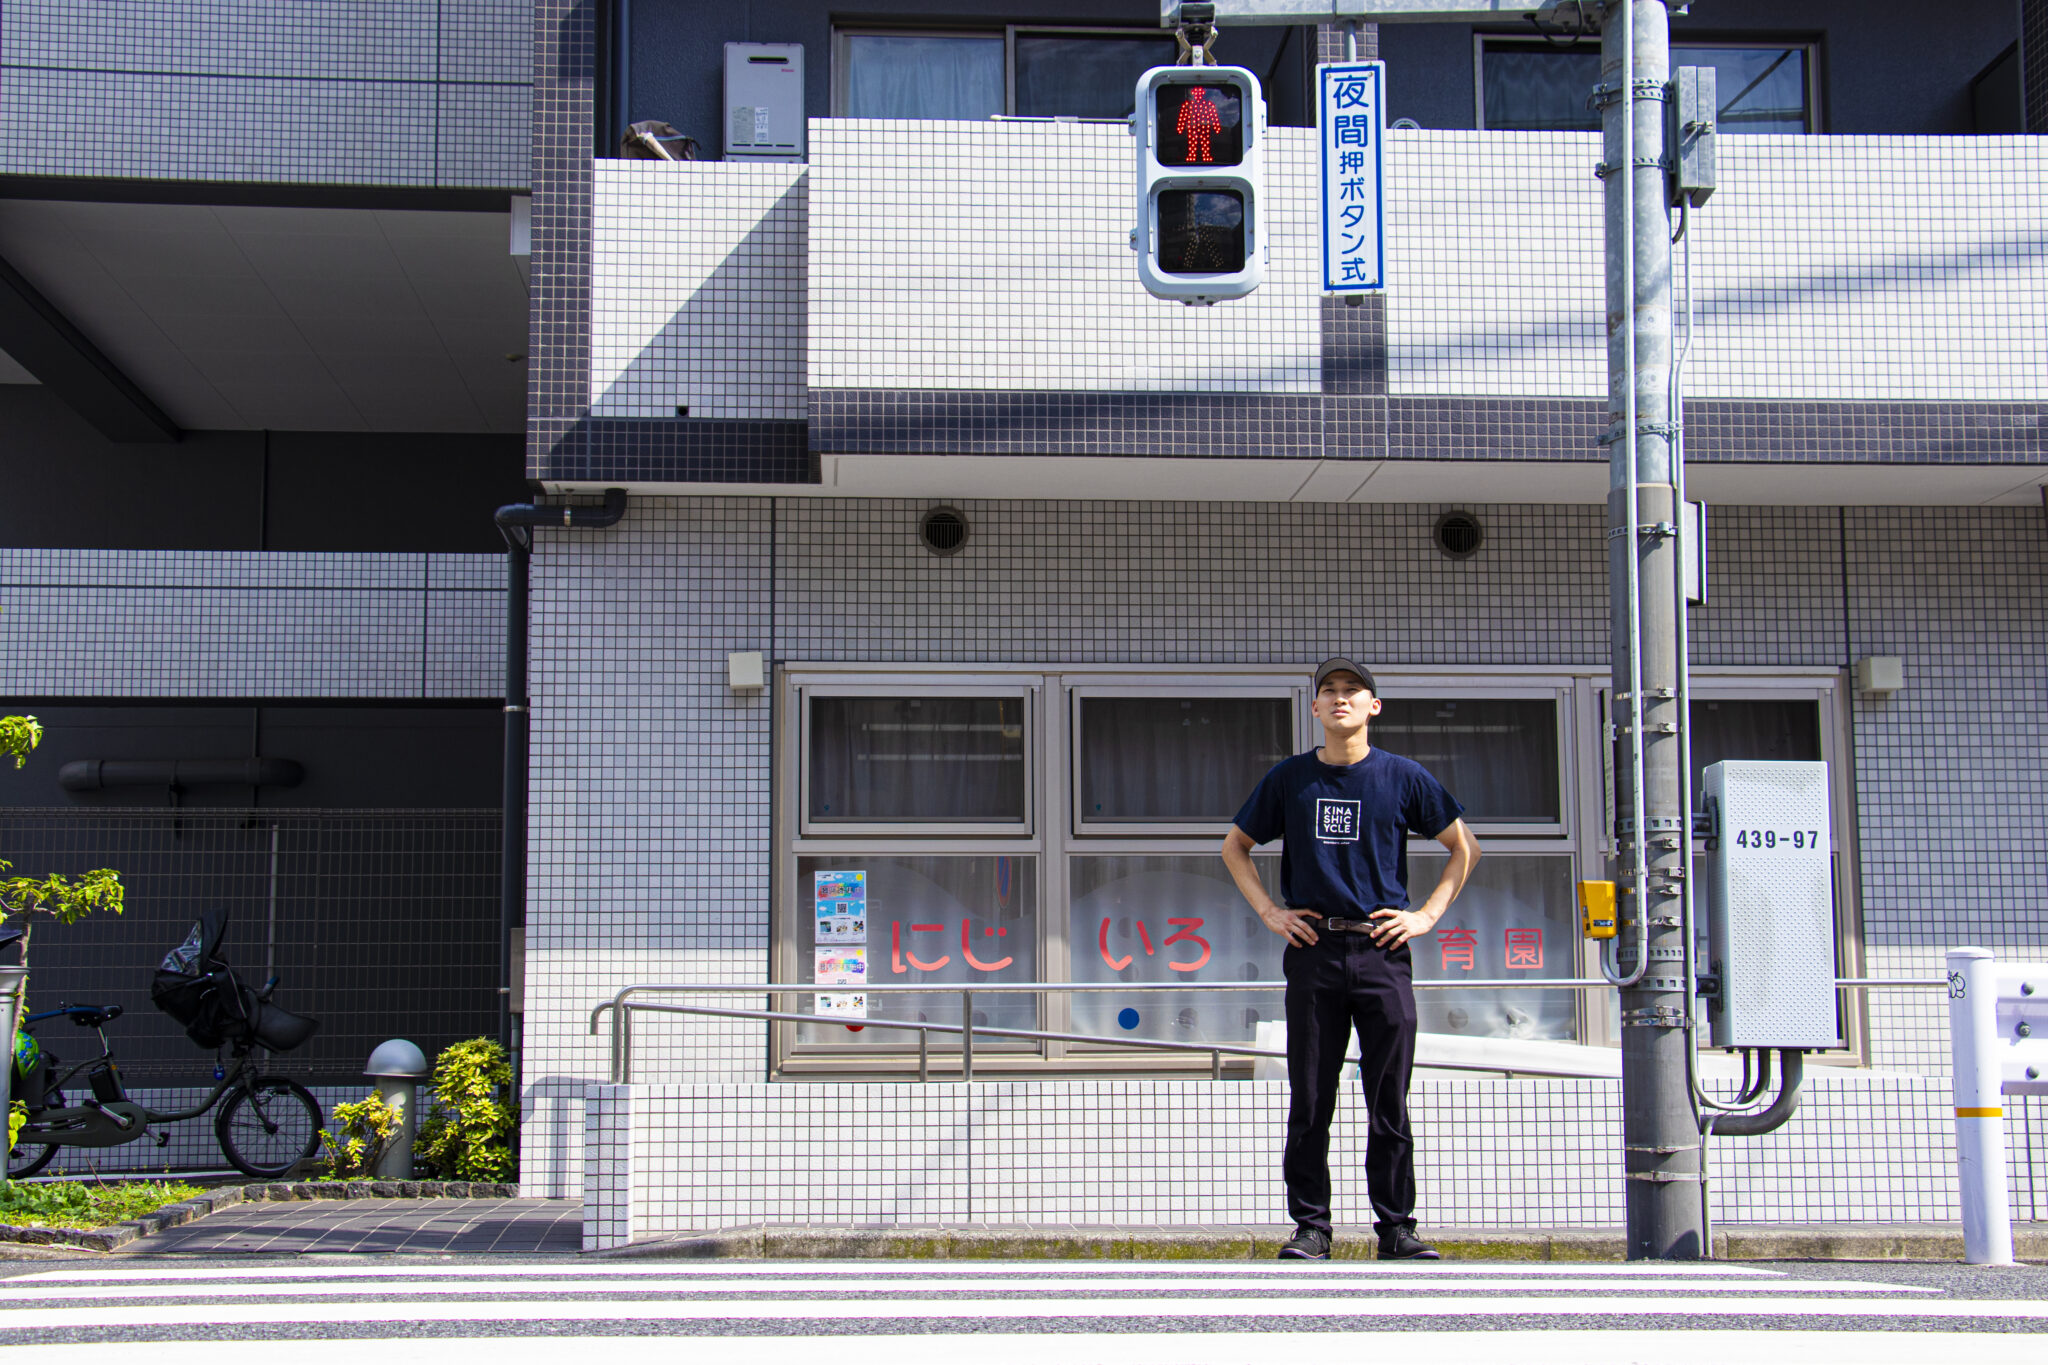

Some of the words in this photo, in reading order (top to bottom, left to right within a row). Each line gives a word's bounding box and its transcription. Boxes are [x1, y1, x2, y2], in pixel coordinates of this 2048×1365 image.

[1333, 74, 1369, 282] 夜間押ボタン式
[1324, 805, 1352, 816] KINA
[1323, 814, 1351, 825] SHIC
[1323, 823, 1351, 834] YCLE
[1736, 829, 1818, 849] 439-97
[1410, 926, 1544, 970] 育園
